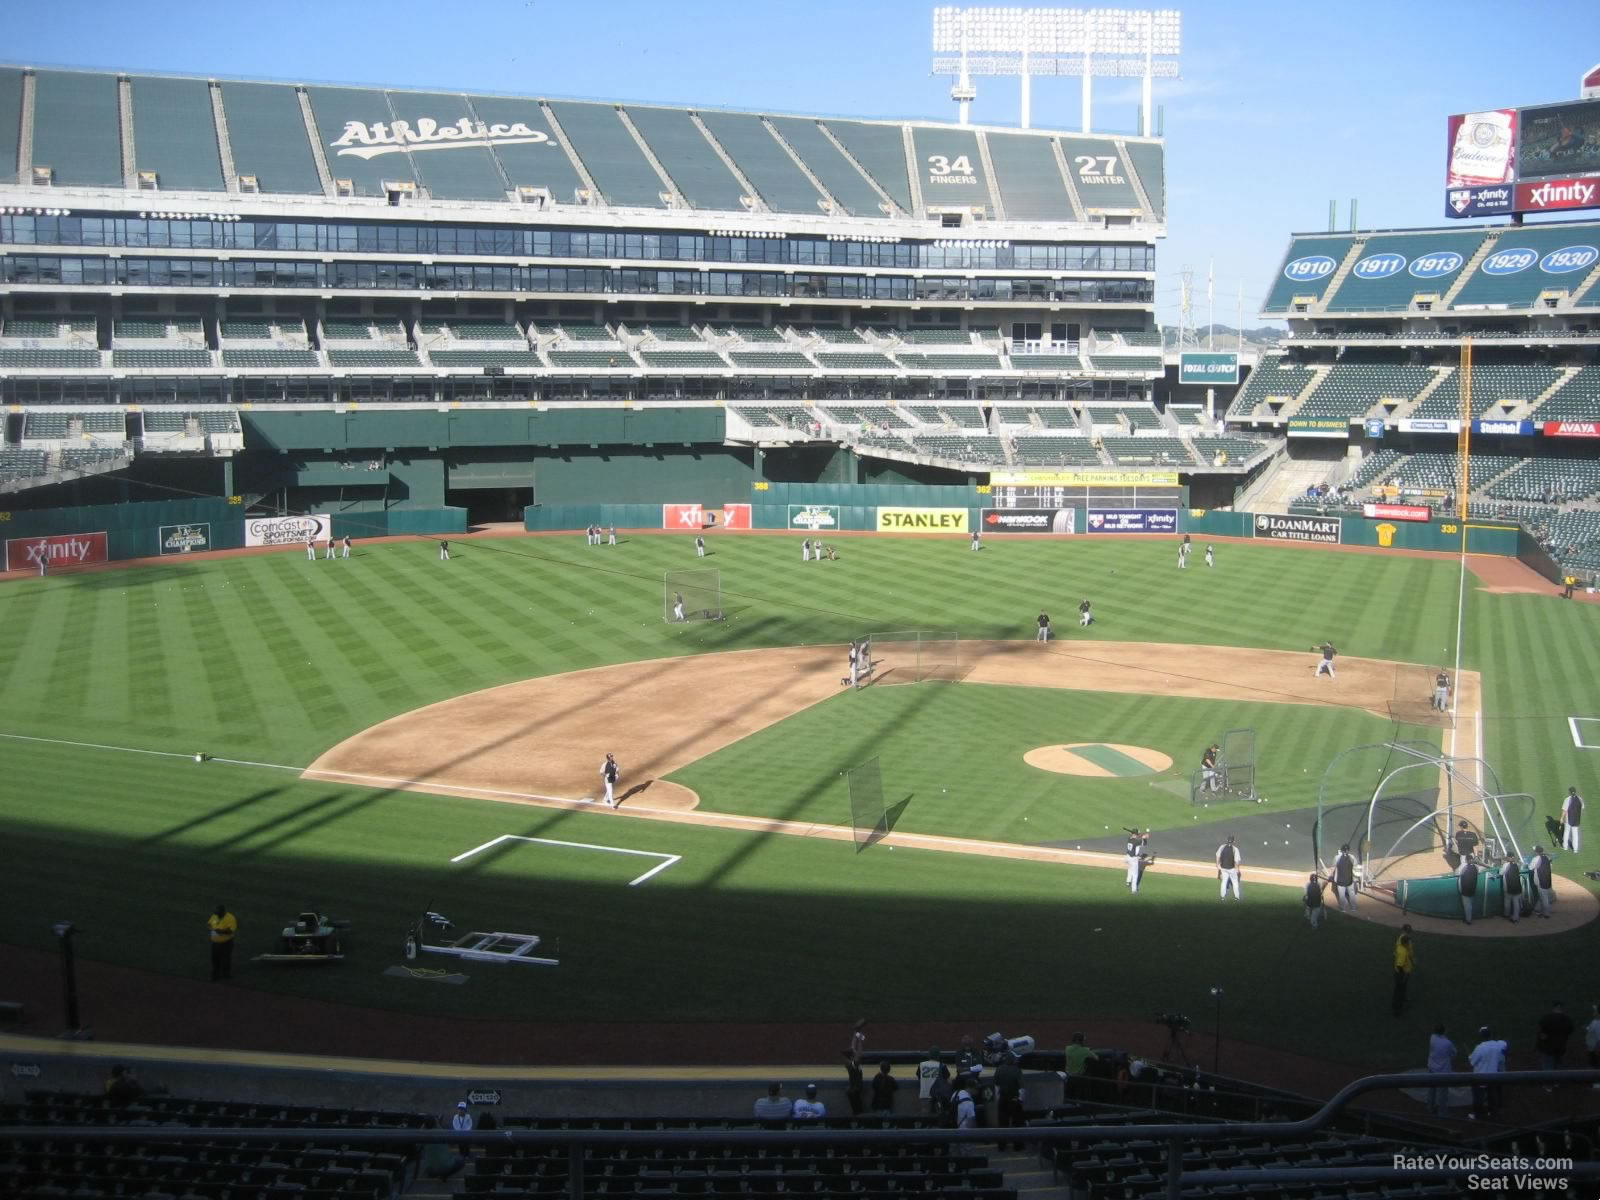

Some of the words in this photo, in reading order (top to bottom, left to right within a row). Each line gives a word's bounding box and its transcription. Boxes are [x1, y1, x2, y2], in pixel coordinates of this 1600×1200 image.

[330, 118, 548, 148] Athletics
[928, 155, 973, 175] 34
[1075, 155, 1118, 175] 27
[930, 175, 977, 185] FINGERS
[1081, 175, 1125, 185] HUNTER
[1478, 189, 1508, 201] xfinity
[1530, 181, 1595, 206] xfinity
[1361, 259, 1398, 273] 1911
[1416, 257, 1455, 272] 1913
[1488, 254, 1531, 269] 1929
[1548, 252, 1590, 267] 1930
[1291, 261, 1330, 275] 1910
[1480, 422, 1521, 434] StubHub!
[1558, 423, 1596, 433] AVAYA
[1073, 474, 1089, 482] FREE
[1090, 474, 1118, 482] PARKING
[882, 512, 963, 527] STANLEY
[1148, 514, 1175, 523] xfinity
[264, 528, 314, 540] SPORTSNET
[1441, 524, 1457, 533] 330
[1271, 530, 1287, 538] CAR
[1288, 531, 1309, 540] TITLE
[1311, 533, 1337, 542] LOANS
[27, 538, 91, 563] xfinity
